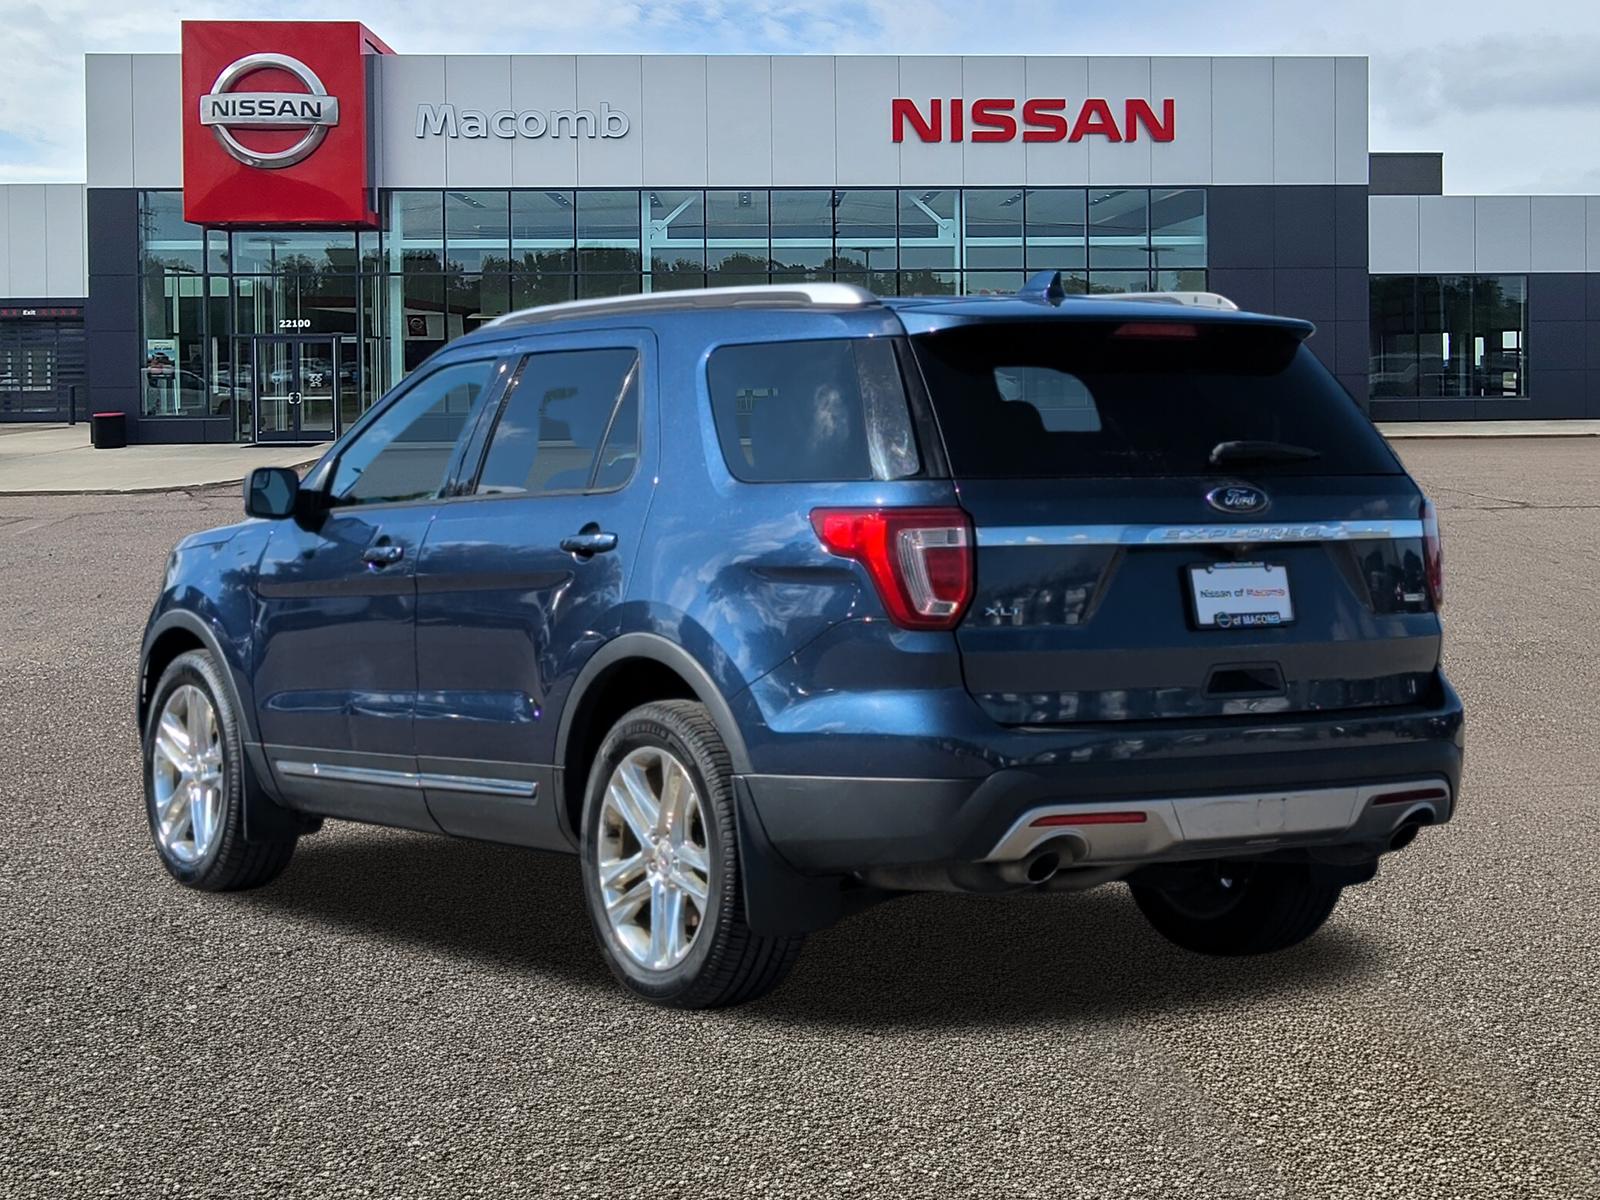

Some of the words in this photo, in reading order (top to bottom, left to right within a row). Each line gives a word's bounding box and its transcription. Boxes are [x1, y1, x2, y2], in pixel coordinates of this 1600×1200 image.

[212, 100, 322, 119] NISSAN
[415, 101, 630, 139] Macomb
[891, 98, 1175, 143] NISSAN
[279, 319, 311, 328] 22100
[1224, 488, 1257, 506] Ford
[1164, 525, 1326, 540] EXPLORER
[1200, 588, 1231, 598] Nissan
[1234, 588, 1244, 597] of
[985, 607, 1020, 616] XLT
